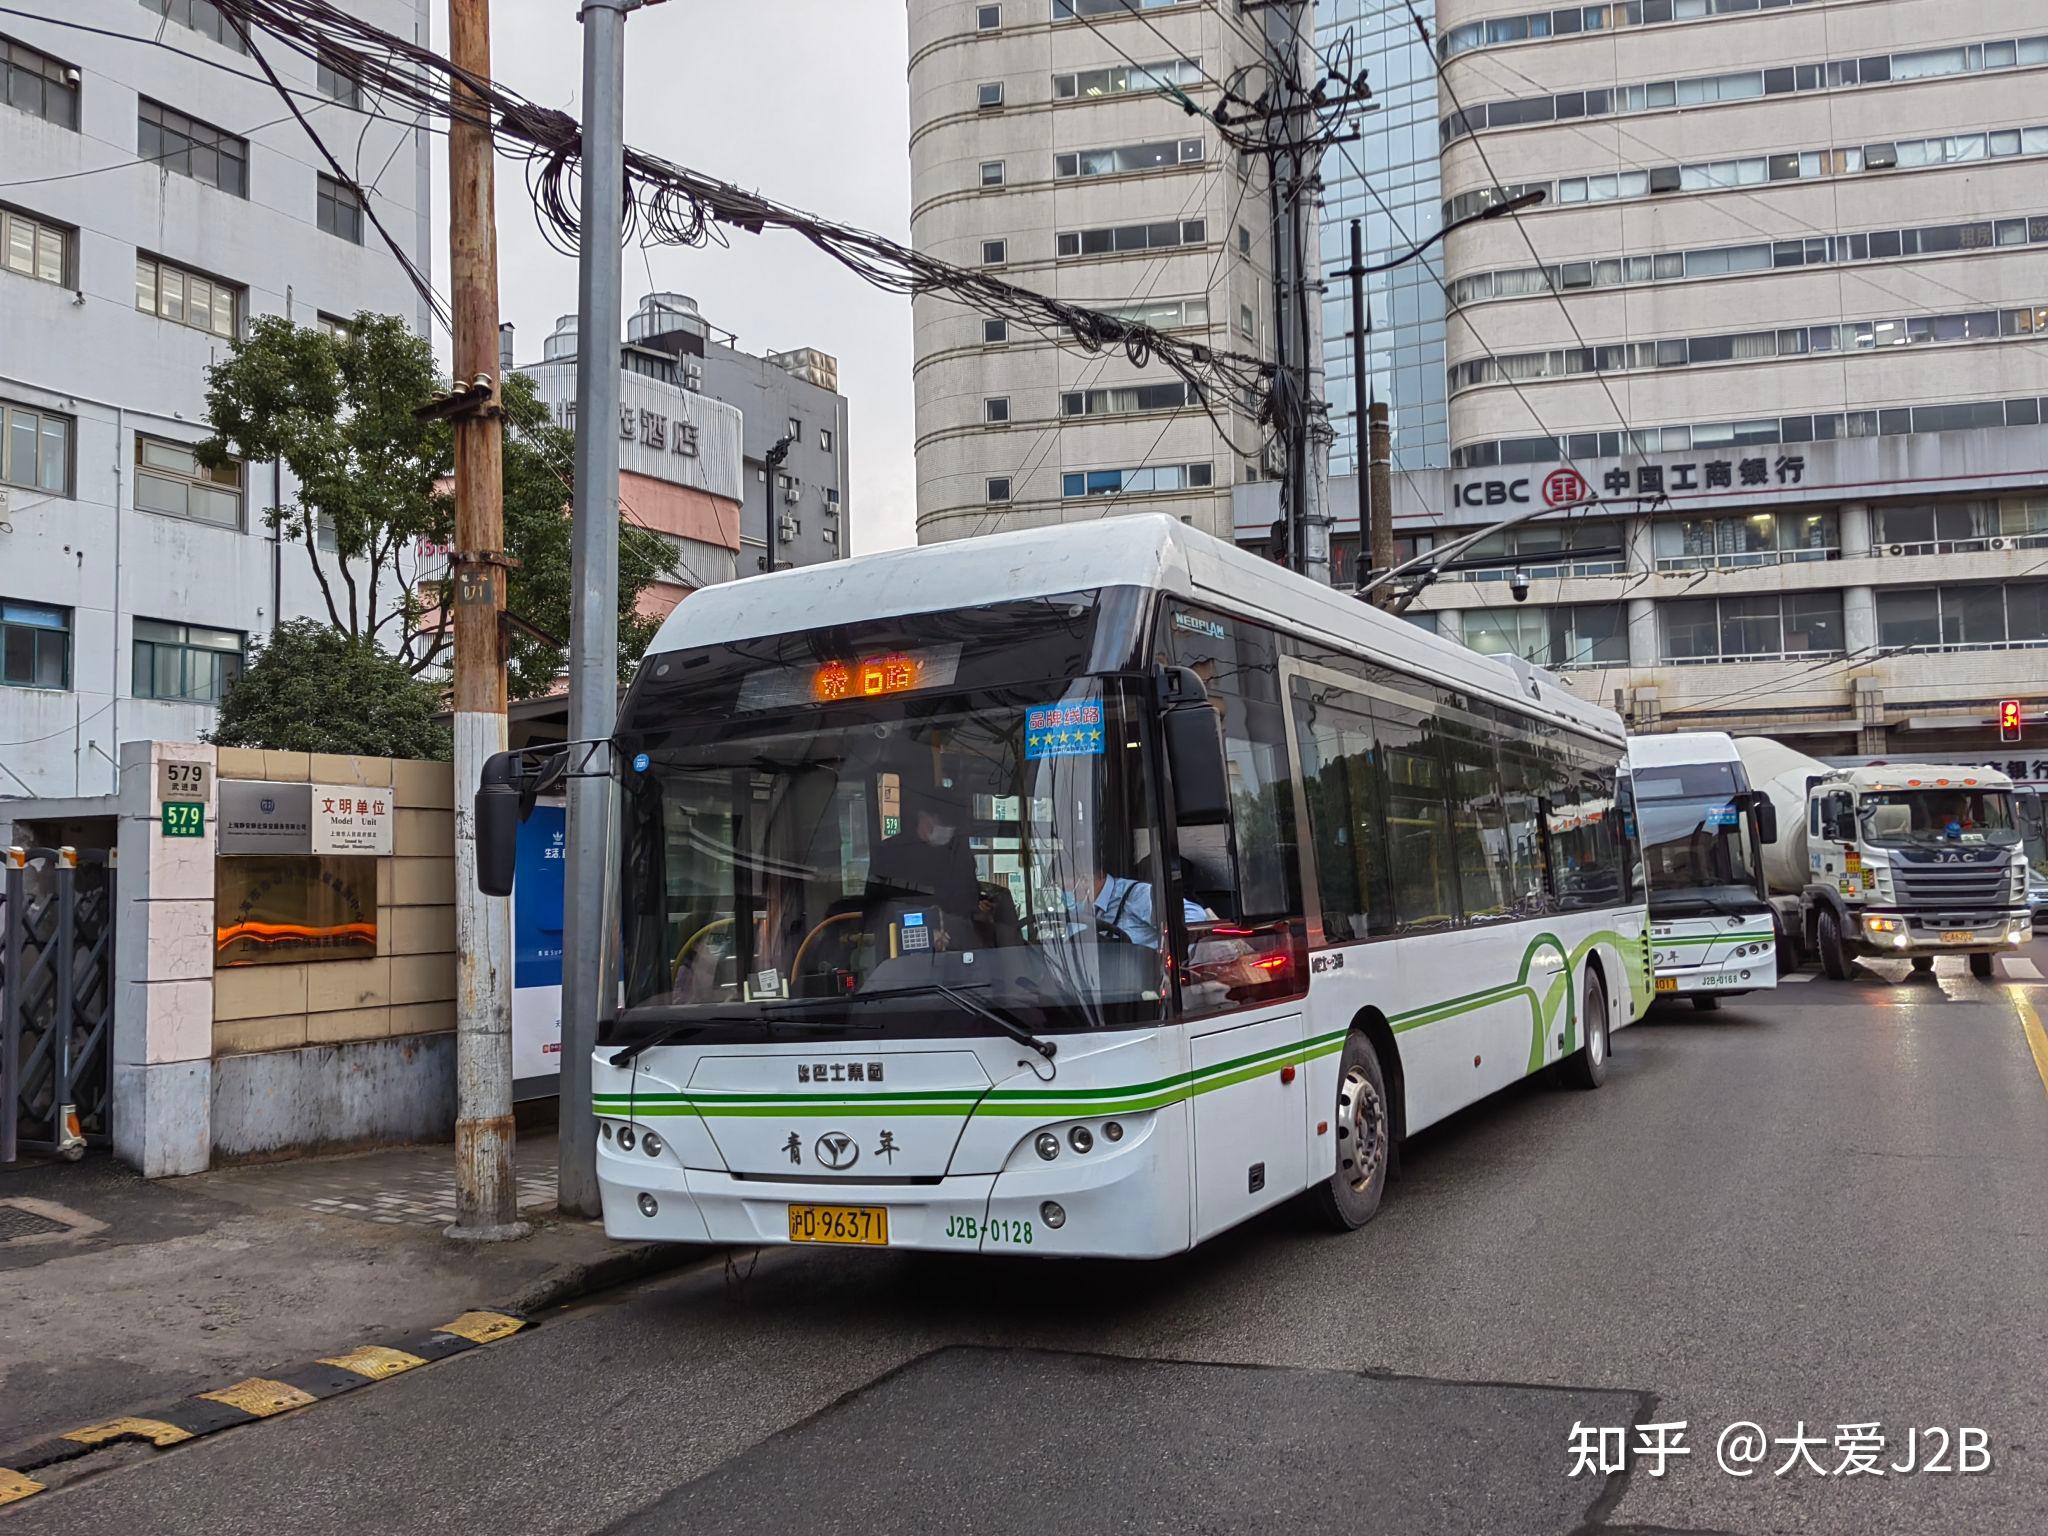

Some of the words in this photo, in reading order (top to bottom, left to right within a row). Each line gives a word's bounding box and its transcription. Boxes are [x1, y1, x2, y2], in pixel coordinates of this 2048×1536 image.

[1603, 455, 1805, 496] 中国工商银行
[1453, 478, 1530, 507] ICBC
[1174, 611, 1225, 638] NEOPLAN
[1029, 706, 1100, 731] 品牌线路
[167, 764, 202, 781] 579
[167, 806, 199, 825] 579
[321, 797, 386, 816] 文明单位
[330, 816, 353, 825] Model
[361, 818, 377, 826] Unit
[1933, 853, 1976, 864] JAC
[874, 1129, 900, 1165] 年
[945, 1215, 1034, 1245] J2B-0128
